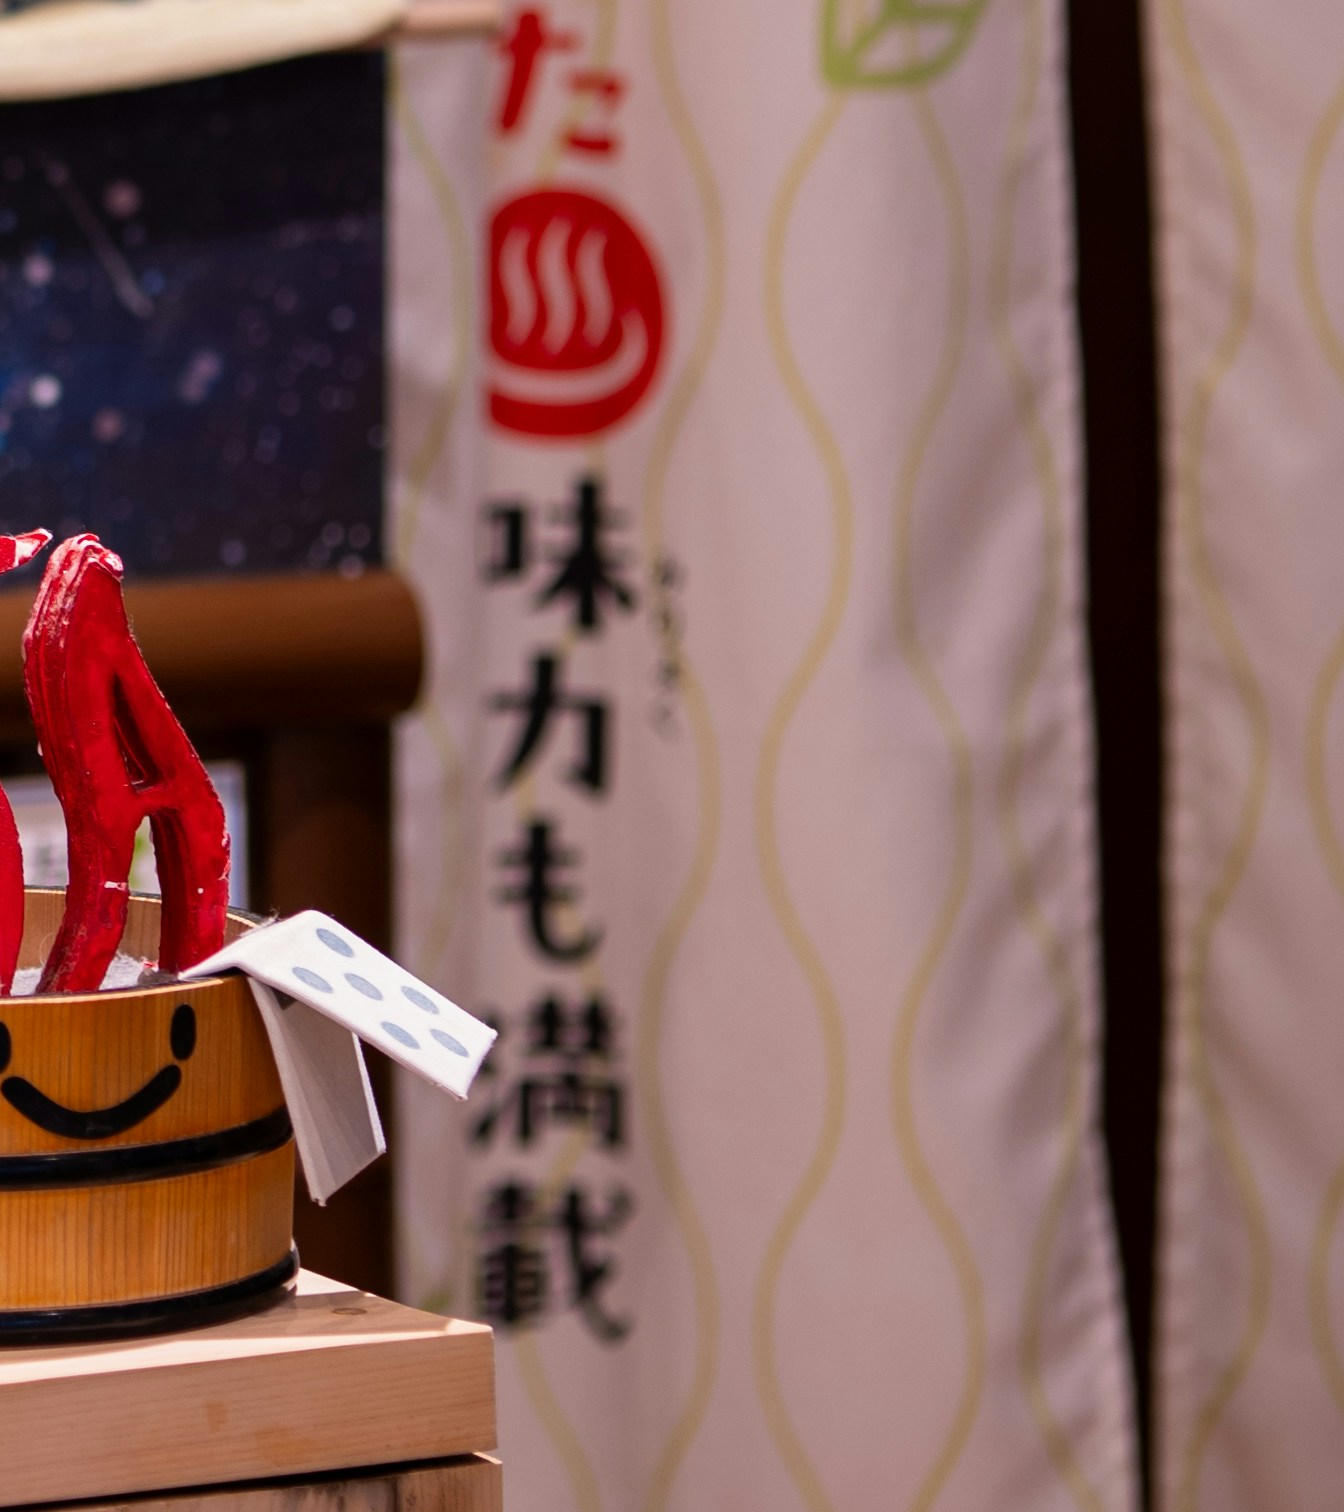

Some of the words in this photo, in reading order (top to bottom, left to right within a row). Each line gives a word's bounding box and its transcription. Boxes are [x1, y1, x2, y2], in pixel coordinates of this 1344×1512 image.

[470, 472, 638, 1344] 味力も満載
